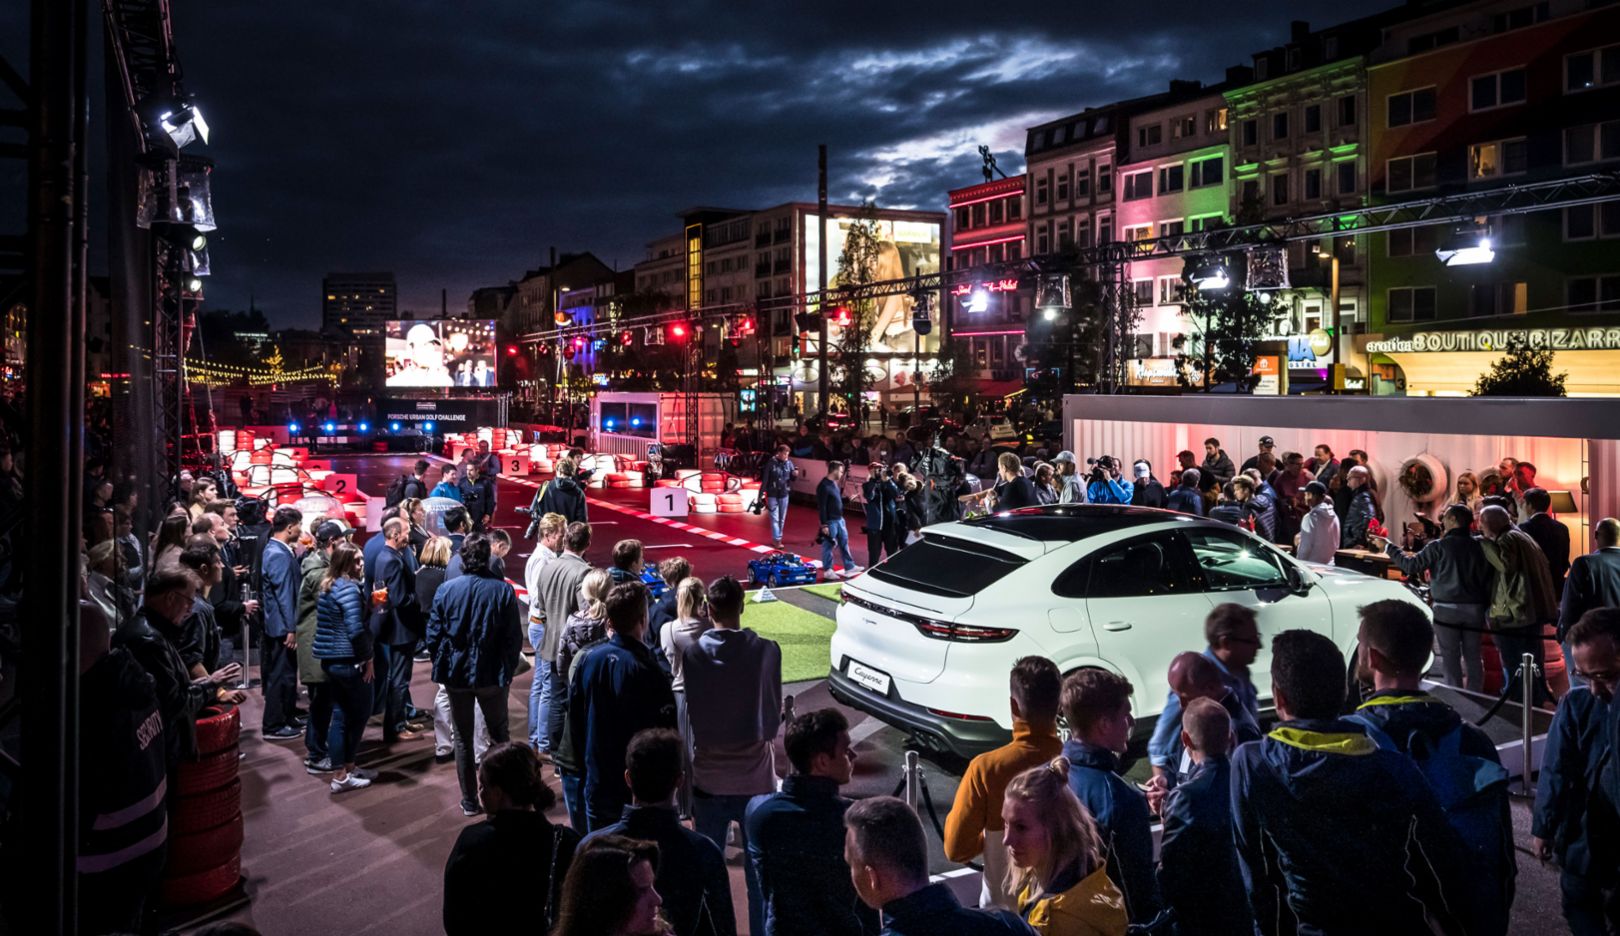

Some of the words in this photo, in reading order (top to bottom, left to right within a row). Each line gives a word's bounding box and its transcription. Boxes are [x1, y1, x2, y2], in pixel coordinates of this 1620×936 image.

[511, 460, 521, 472] 3
[335, 480, 347, 494] 2
[664, 494, 673, 511] 1
[854, 667, 883, 686] Cayenne
